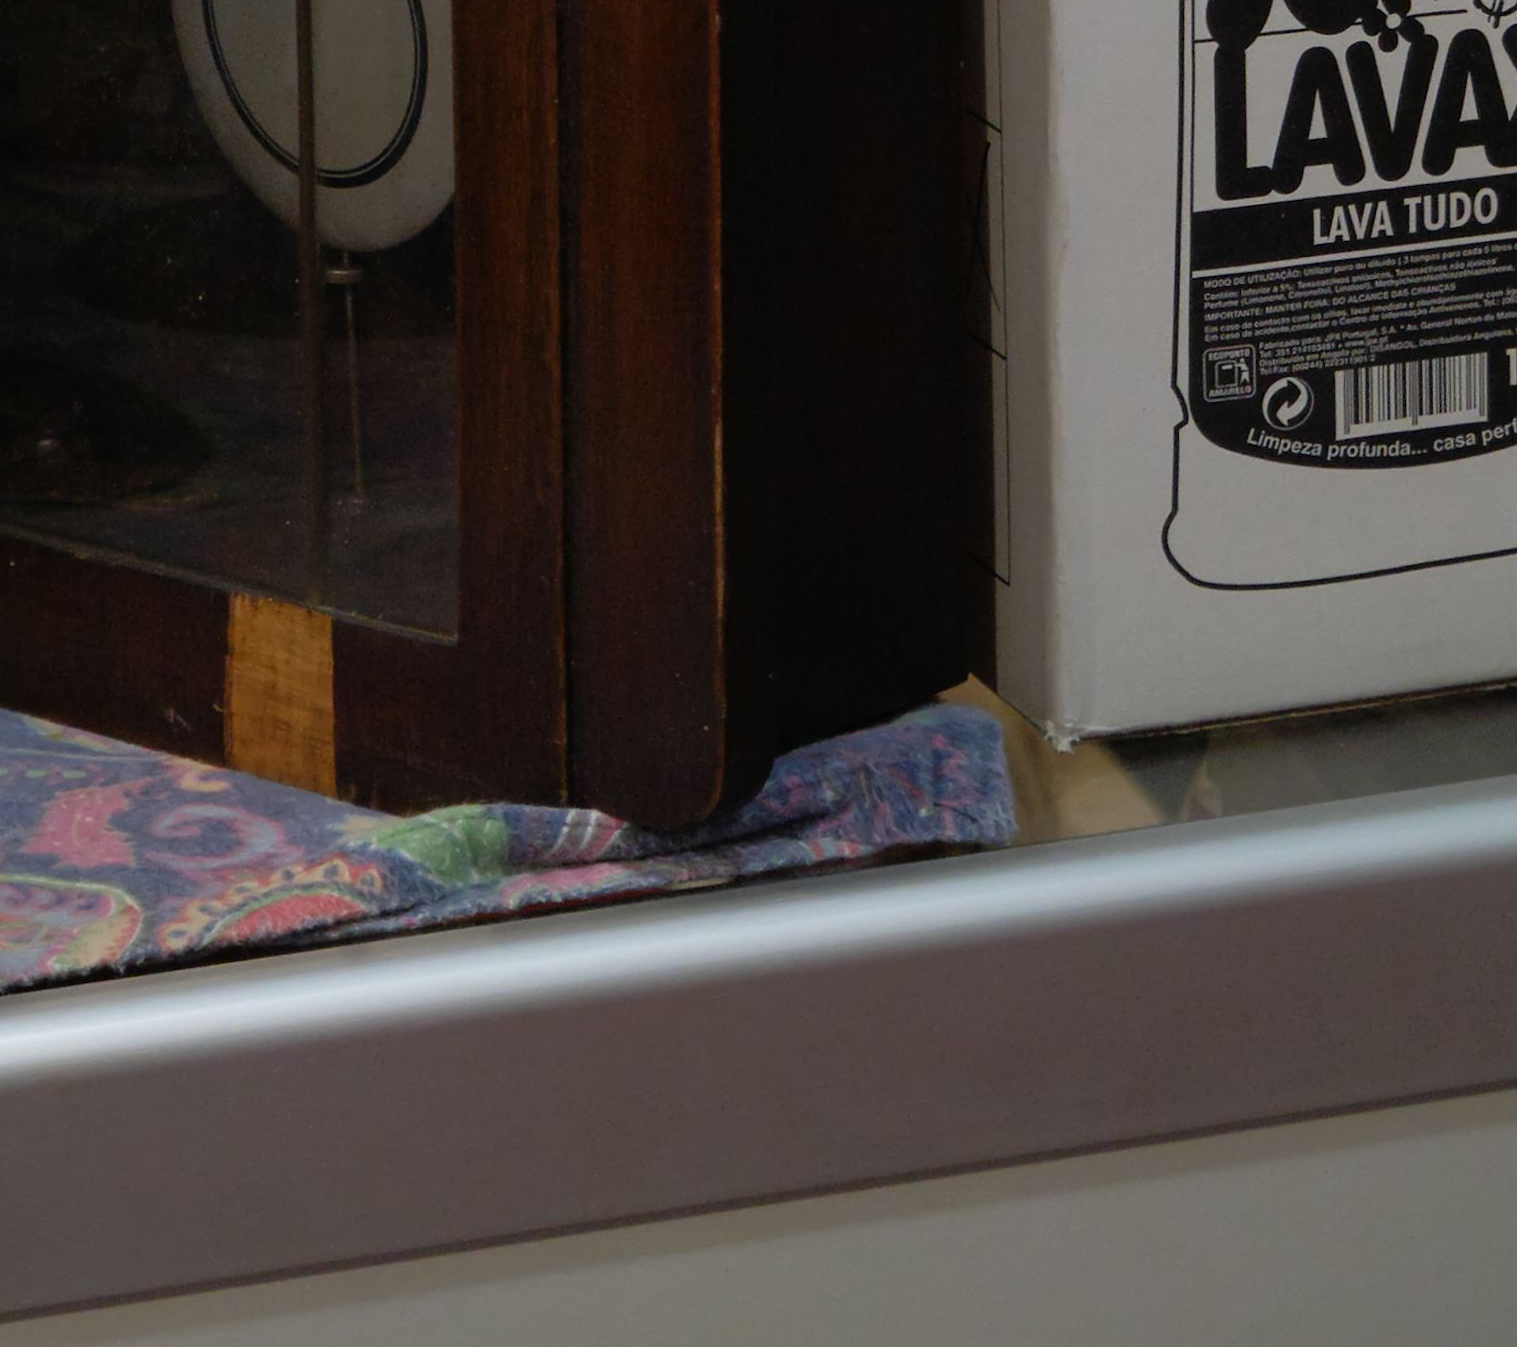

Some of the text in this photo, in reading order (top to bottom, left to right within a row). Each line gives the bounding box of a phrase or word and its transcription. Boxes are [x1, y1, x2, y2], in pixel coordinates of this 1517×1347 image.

[1213, 23, 1517, 200] LAVA
[1313, 187, 1499, 246] LAVA TUDO
[1203, 279, 1231, 288] MODO
[1265, 303, 1301, 314] MANTER
[1331, 297, 1345, 305] DO
[1346, 291, 1388, 303] ALCANCE
[1389, 289, 1408, 298] DAS
[1410, 282, 1455, 295] CRIANÇAS
[1246, 427, 1322, 457] Limpeza
[1327, 437, 1428, 461] profunda...
[1433, 432, 1476, 453] casa
